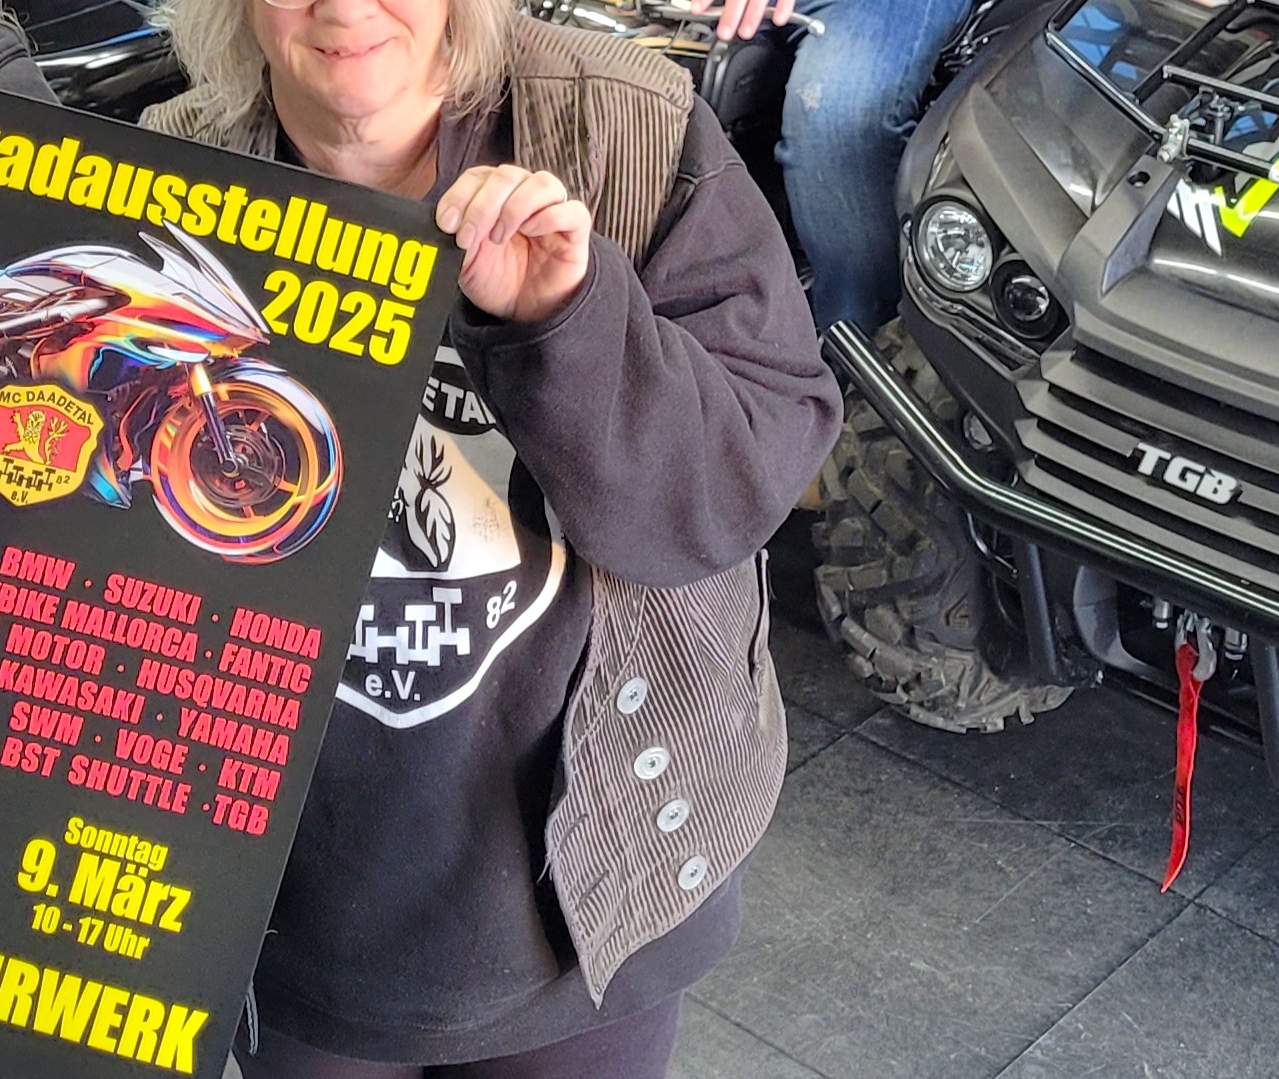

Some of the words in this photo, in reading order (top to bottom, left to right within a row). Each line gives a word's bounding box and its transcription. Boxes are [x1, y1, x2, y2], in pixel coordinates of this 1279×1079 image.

[260, 269, 415, 368] 2025
[25, 389, 94, 426] DAADETAL
[1136, 441, 1238, 506] TGB
[0, 546, 76, 590] BMW
[104, 573, 202, 625] SUZUKI
[229, 606, 323, 659] HONDA
[485, 579, 518, 630] 82
[5, 623, 107, 676] MOTOR
[135, 658, 302, 730] HUSQVARNA
[60, 599, 199, 663] MALLORCA
[218, 641, 313, 694] FANTIC
[365, 669, 422, 702] e.V.
[9, 700, 85, 746] SWM
[115, 728, 189, 775] VOGE
[217, 758, 282, 801] KTM
[177, 707, 291, 767] YAMAHA
[0, 736, 62, 778] BST
[67, 754, 192, 815] SHUTTLE
[211, 793, 271, 836] TGB
[63, 816, 170, 872] Sonntag
[17, 837, 61, 899] 9.
[67, 852, 193, 933] März
[30, 901, 63, 935] 10
[76, 914, 108, 947] 17
[103, 921, 152, 961] Uhr
